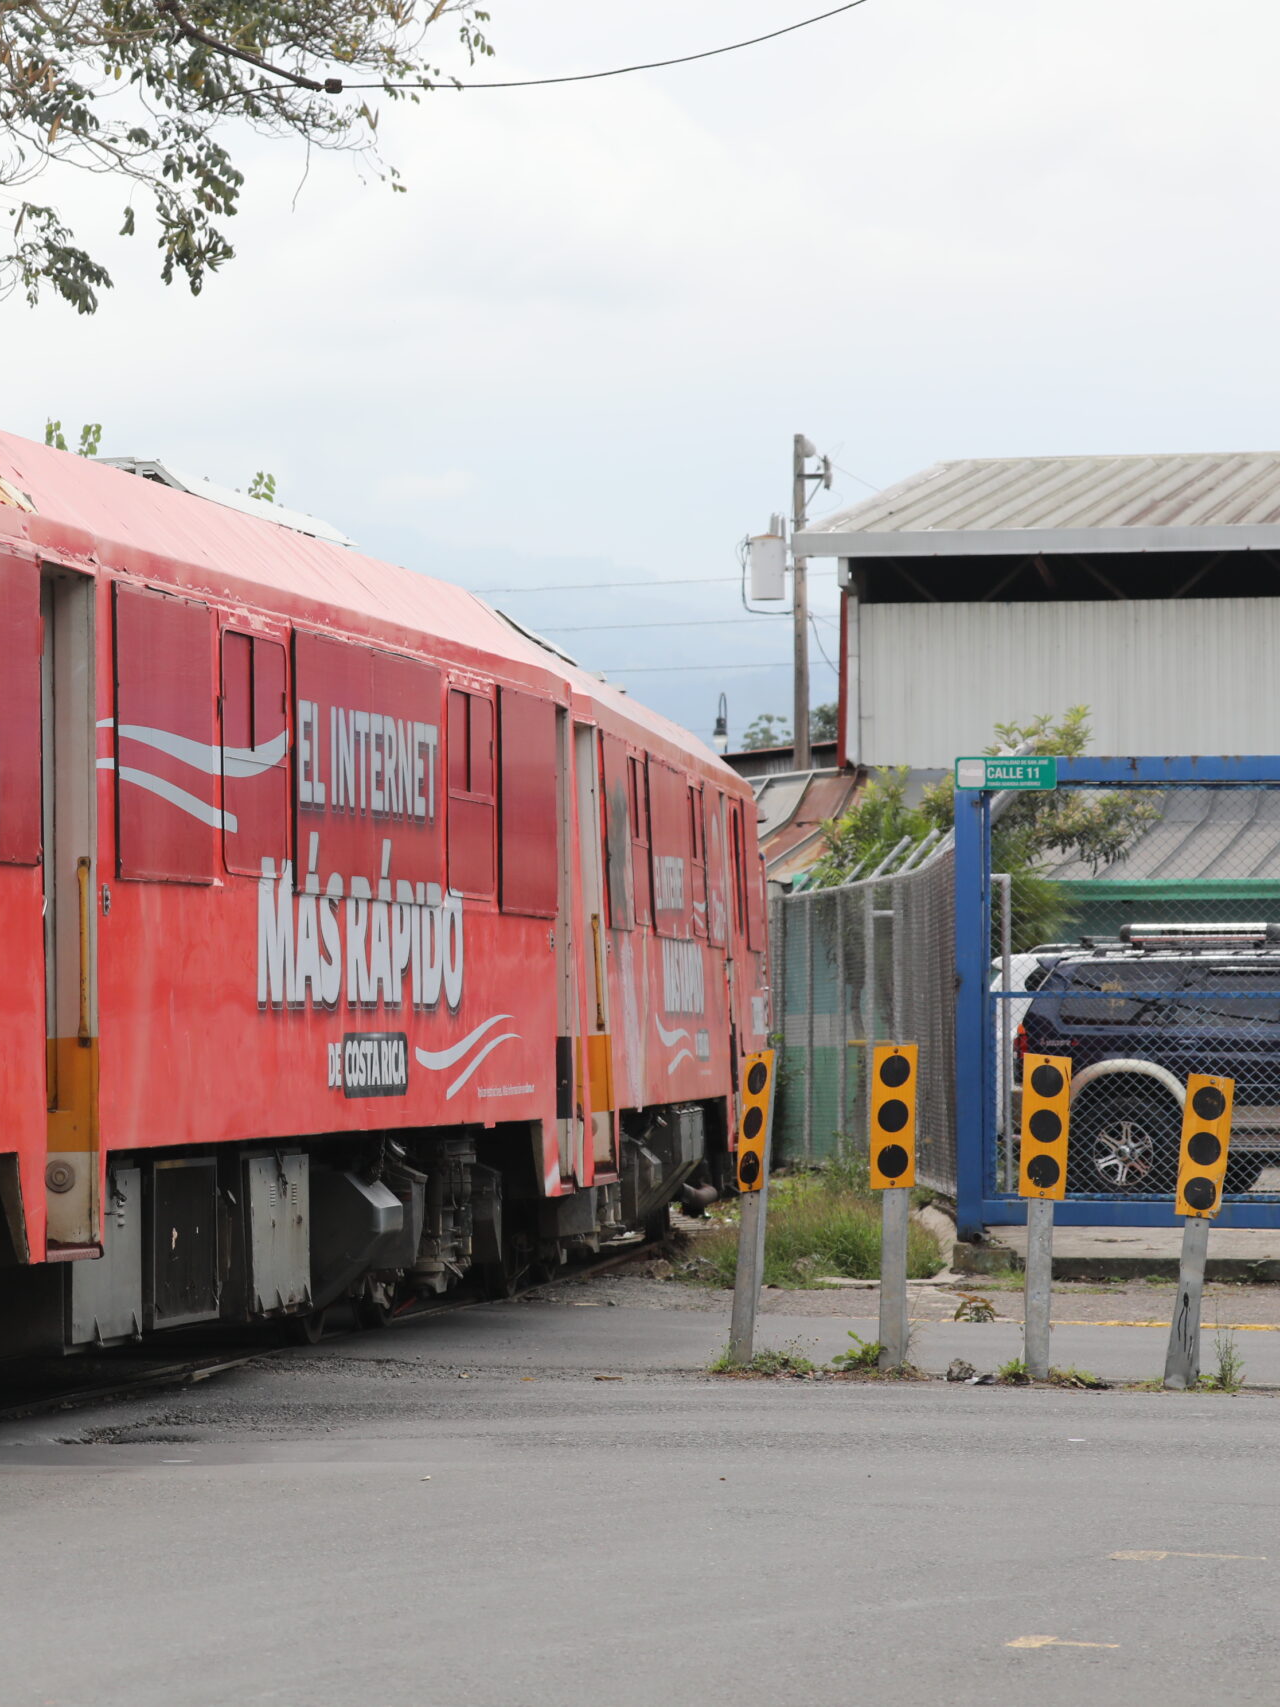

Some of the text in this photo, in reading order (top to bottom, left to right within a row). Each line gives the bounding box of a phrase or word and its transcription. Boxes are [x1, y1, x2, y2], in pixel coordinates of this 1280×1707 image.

[299, 699, 438, 818] EL INTERNET
[987, 767, 1040, 779] CALLE 11
[257, 831, 464, 1014] MÁS RÁPIDO
[328, 1040, 406, 1087] DE COSTA RICA
